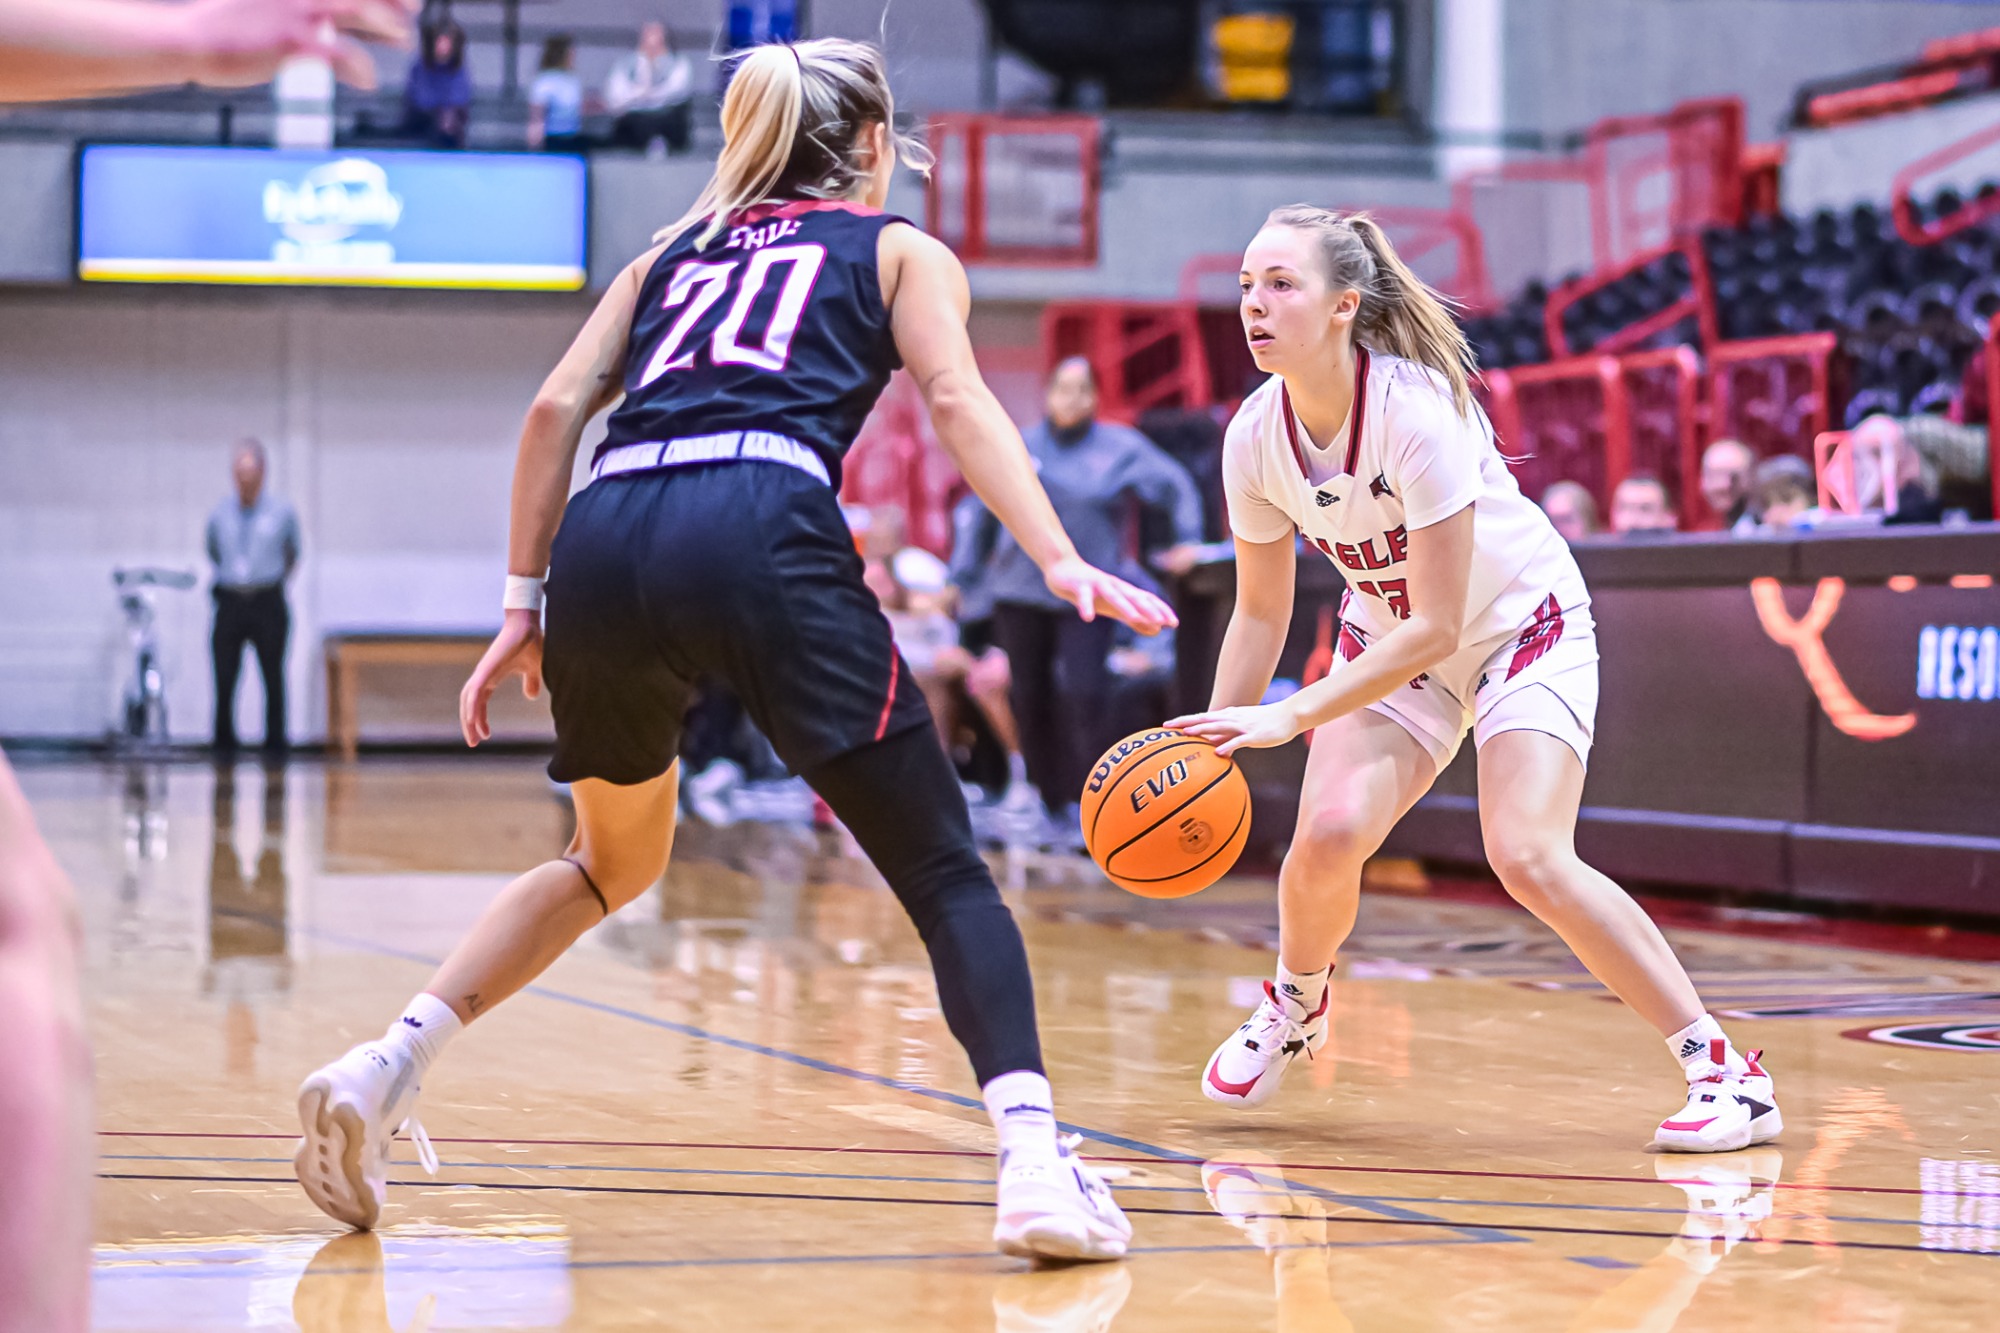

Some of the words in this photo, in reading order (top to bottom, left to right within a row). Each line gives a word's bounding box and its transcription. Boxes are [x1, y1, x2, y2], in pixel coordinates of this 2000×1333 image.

[633, 241, 828, 390] 20
[1916, 624, 2000, 701] RESO
[1087, 730, 1185, 793] Wilson
[1129, 759, 1188, 815] EVO
